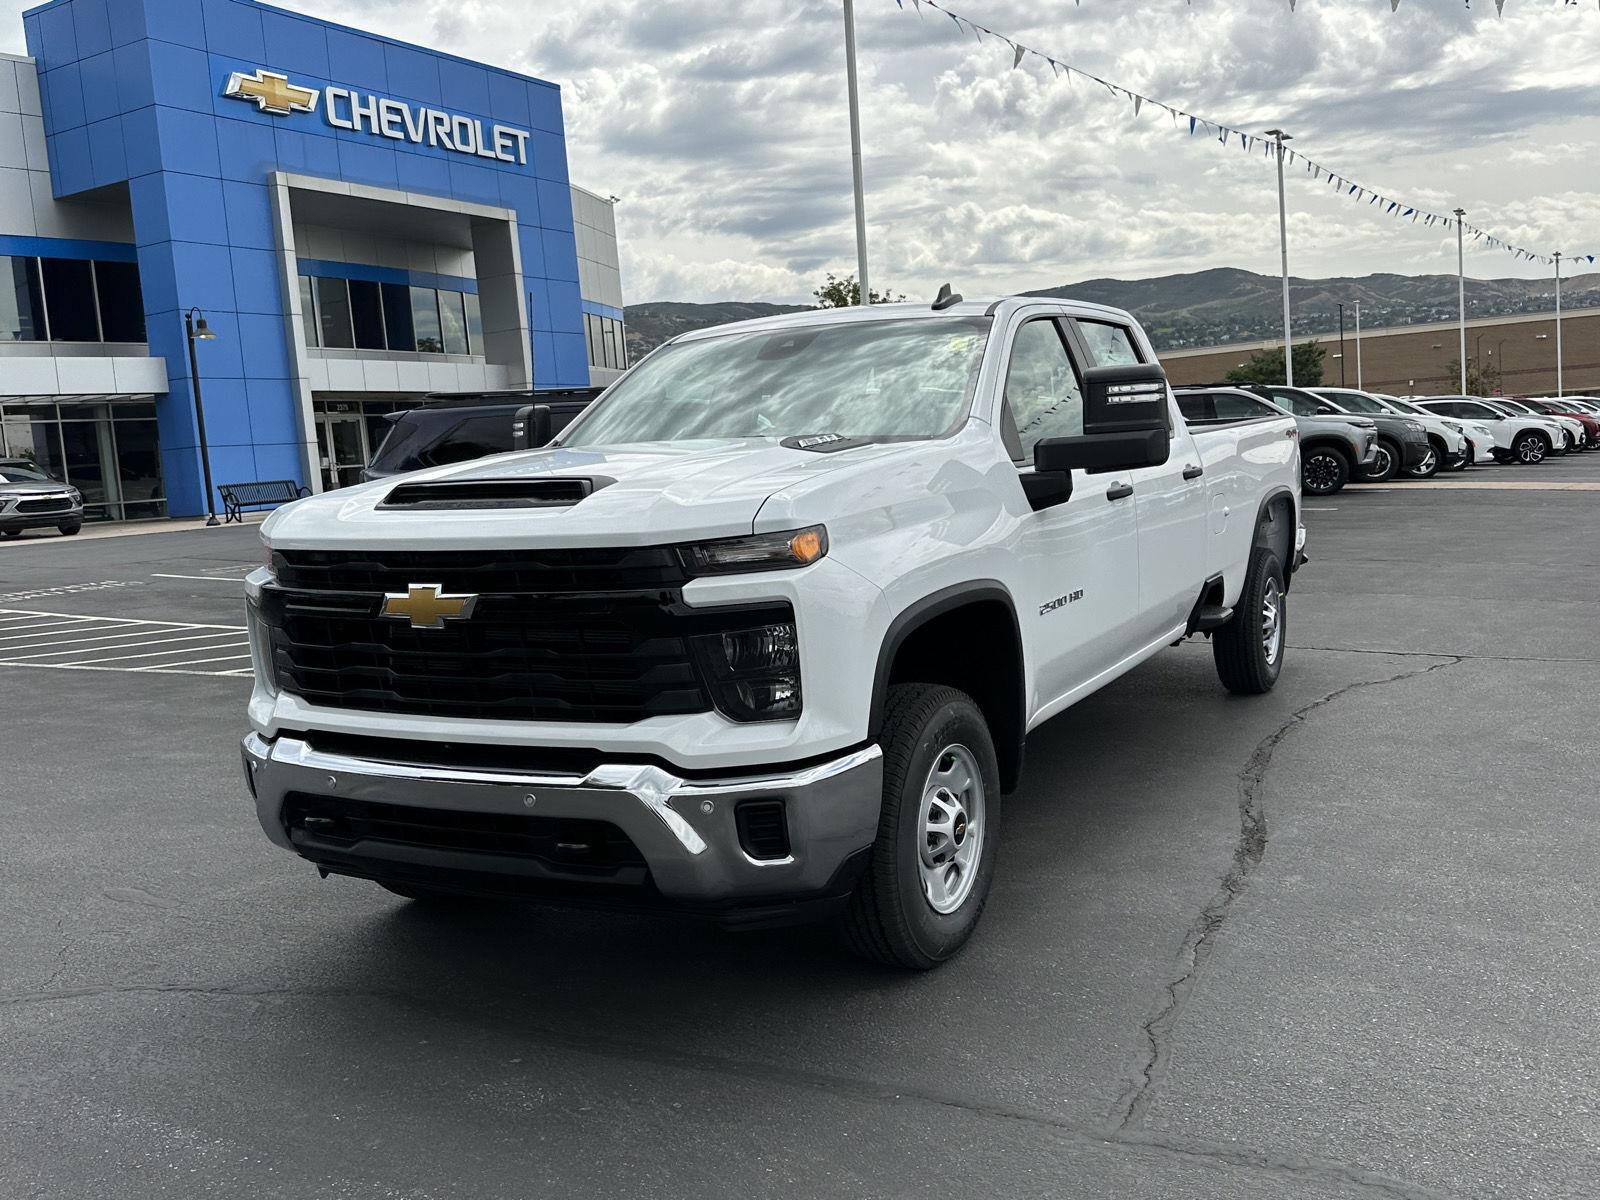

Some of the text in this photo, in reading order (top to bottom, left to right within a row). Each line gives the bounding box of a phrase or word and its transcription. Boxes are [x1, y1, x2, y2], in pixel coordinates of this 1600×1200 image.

[324, 85, 530, 165] CHEVROLET
[1039, 589, 1084, 616] 2500 HD
